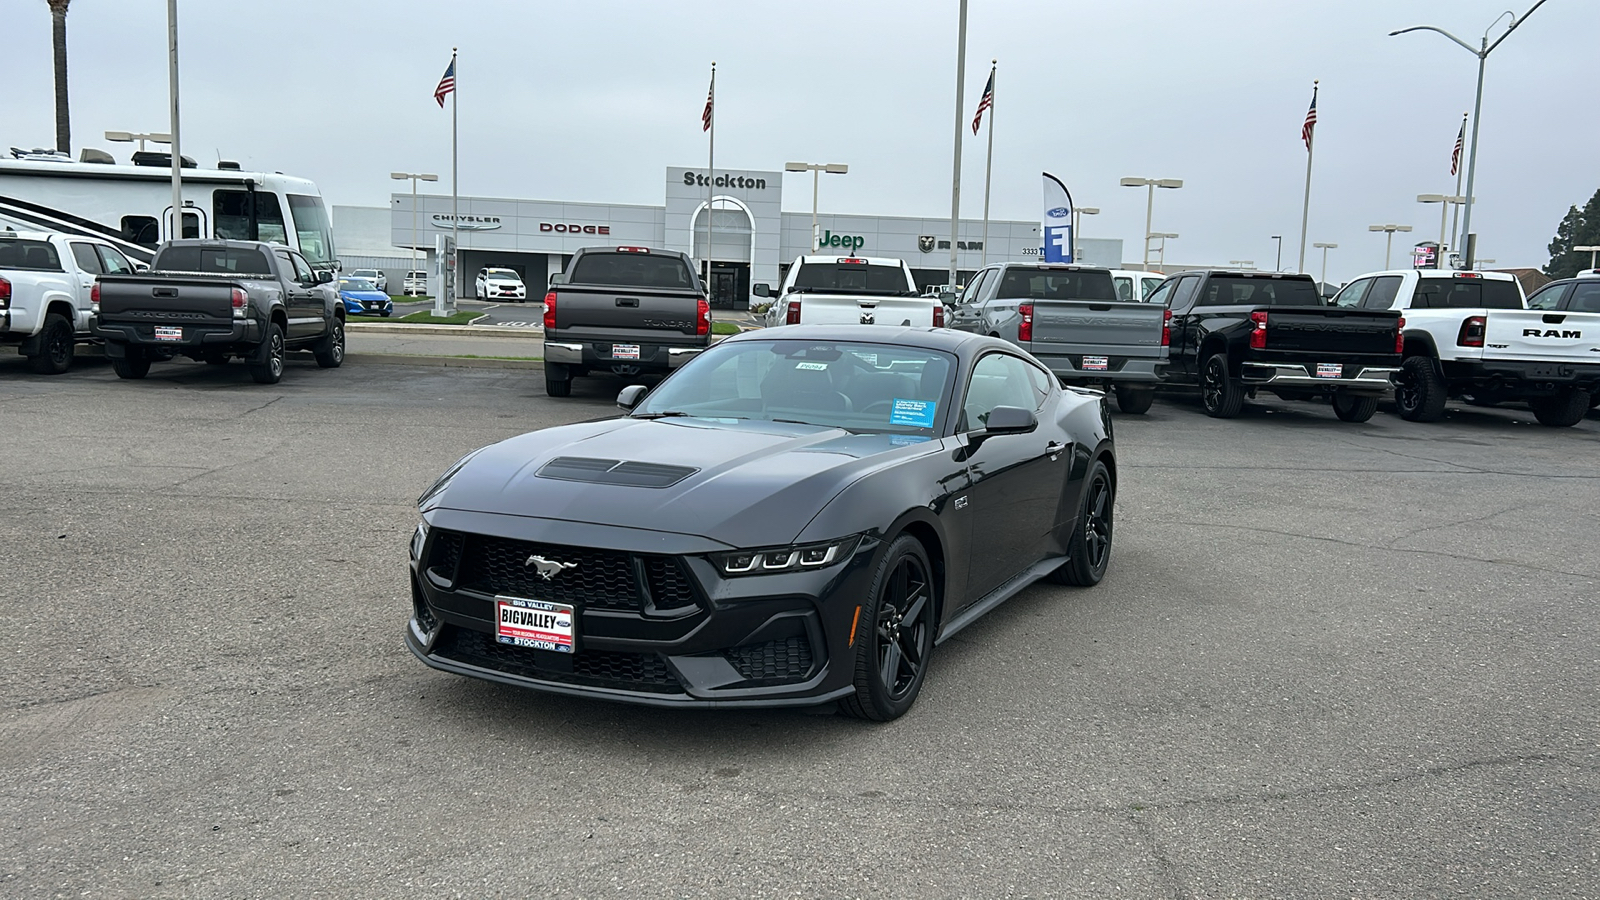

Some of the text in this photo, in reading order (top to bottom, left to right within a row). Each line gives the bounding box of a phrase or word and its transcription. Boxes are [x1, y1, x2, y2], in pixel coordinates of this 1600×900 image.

[684, 172, 766, 190] Stockton
[540, 222, 610, 235] DODGE
[820, 230, 864, 252] Jeep
[644, 319, 694, 328] TUNDRA
[1042, 315, 1156, 327] CHEVROLET
[1278, 322, 1390, 334] CHEVROLET
[1522, 329, 1582, 338] RAM
[527, 602, 553, 610] VALLEY
[502, 608, 556, 629] BIGVALLEY
[514, 638, 556, 650] STOCKTON
